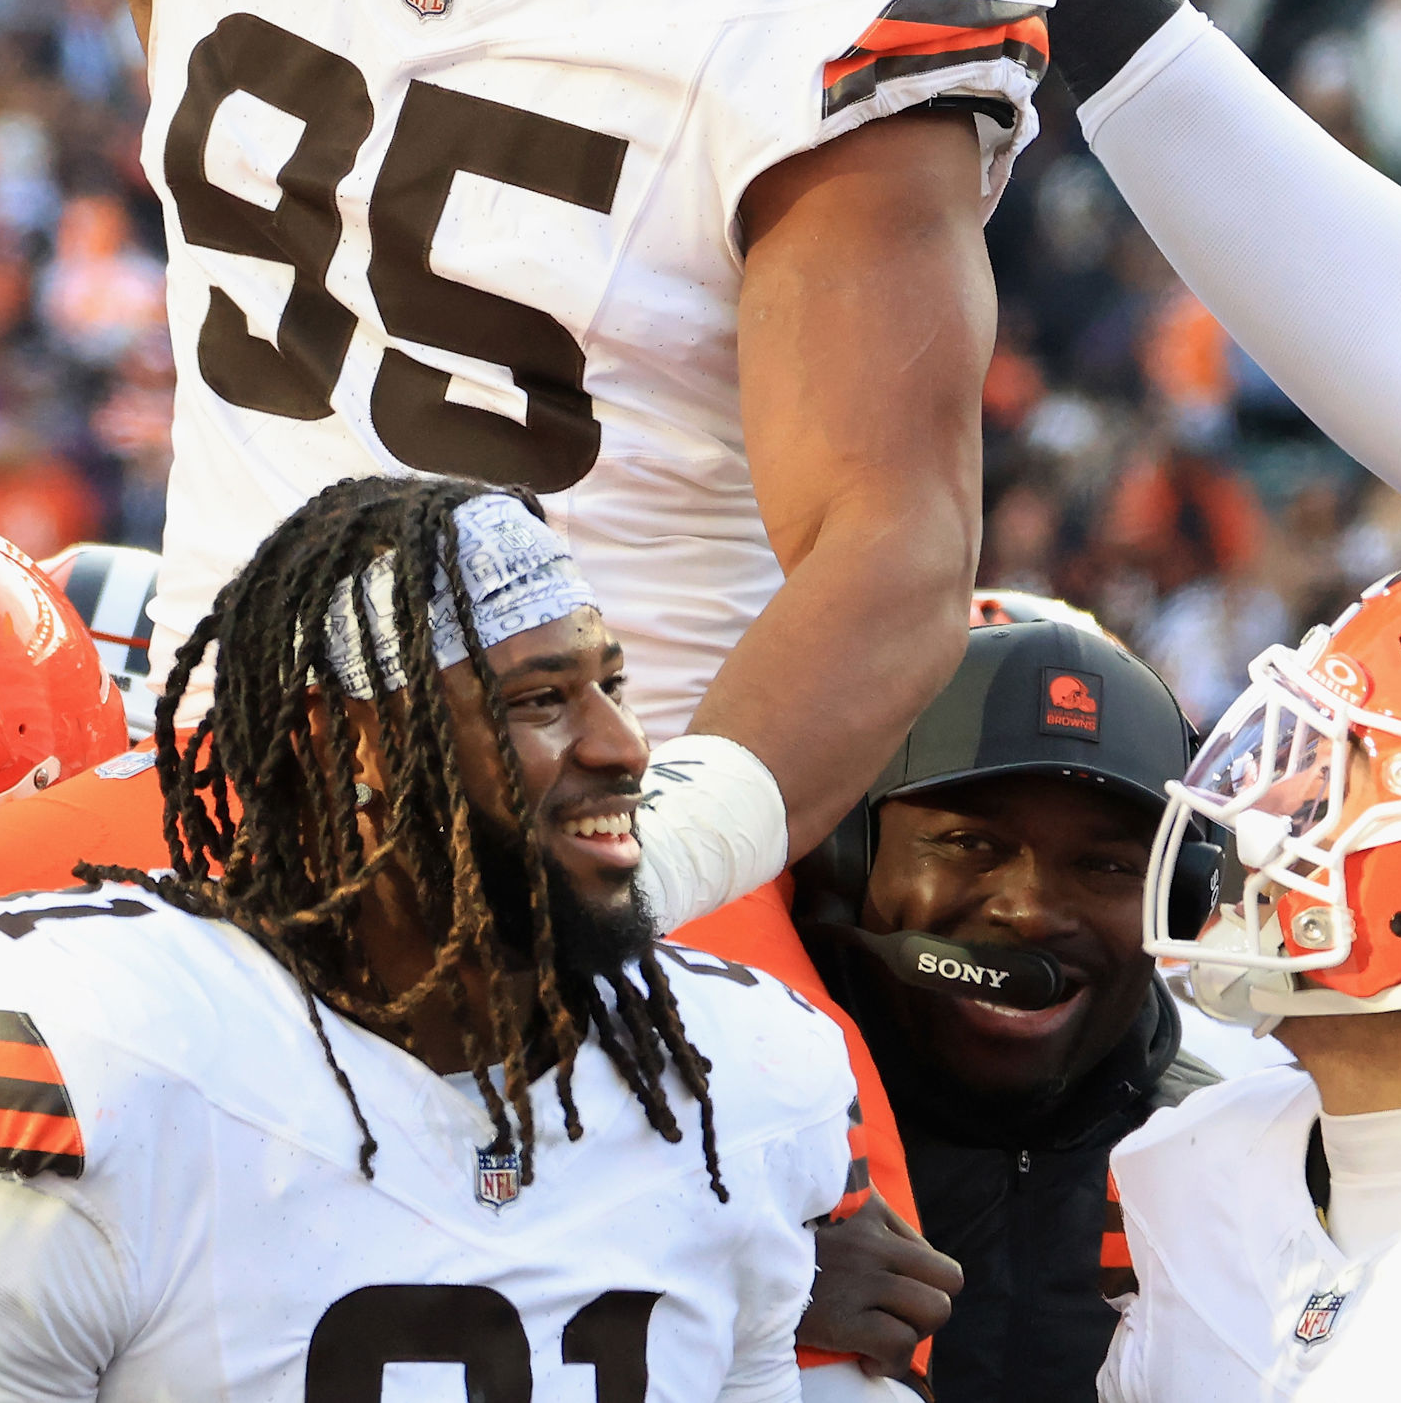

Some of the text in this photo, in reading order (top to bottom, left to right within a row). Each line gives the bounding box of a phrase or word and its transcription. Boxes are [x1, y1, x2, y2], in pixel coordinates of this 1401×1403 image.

[164, 12, 629, 494] 95
[1047, 714, 1097, 732] BROWNS
[918, 952, 1010, 988] SONY
[483, 1172, 516, 1201] NFL
[1298, 1311, 1330, 1338] NFL
